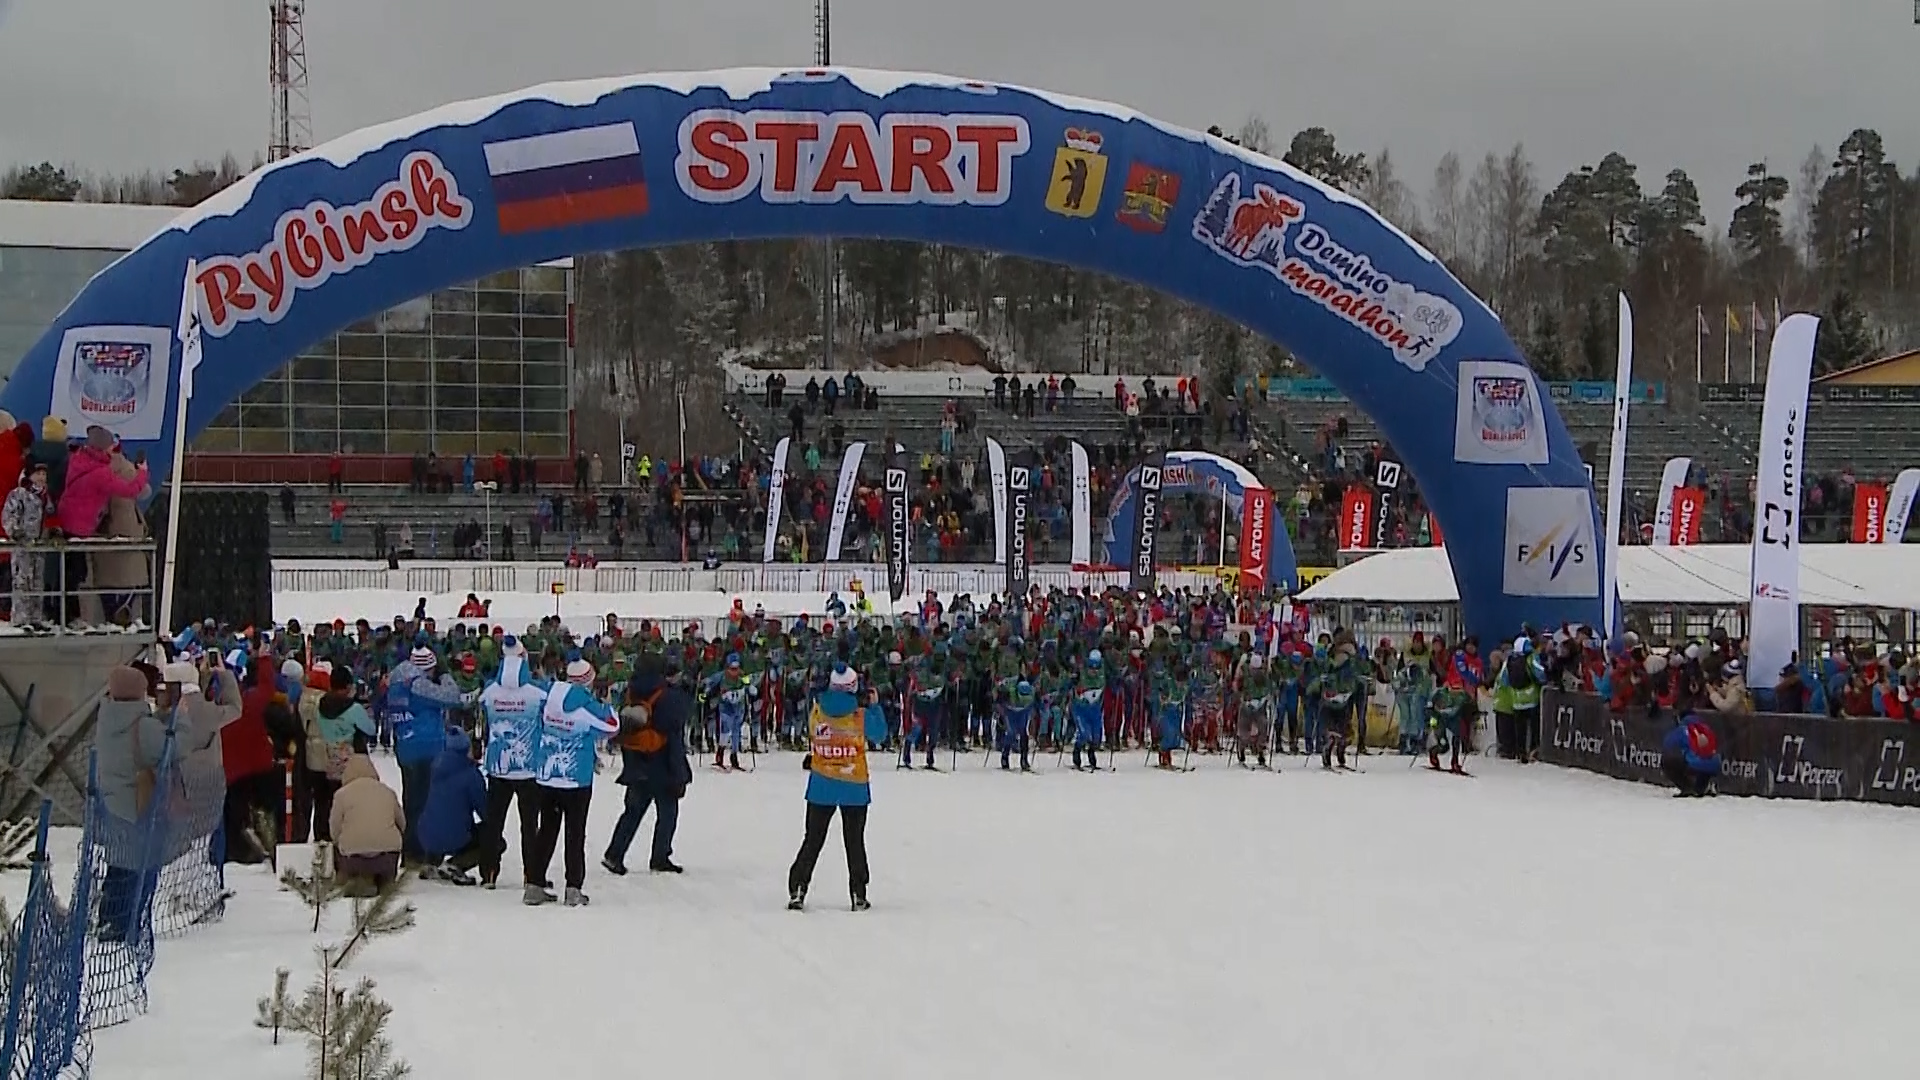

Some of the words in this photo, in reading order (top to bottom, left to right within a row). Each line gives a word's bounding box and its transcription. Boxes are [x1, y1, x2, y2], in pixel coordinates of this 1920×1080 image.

[688, 120, 1018, 192] START
[196, 157, 463, 326] Rybinsk
[1300, 229, 1388, 294] Demino
[1281, 262, 1409, 348] marathon
[1250, 496, 1266, 561] ATOMIC
[811, 743, 857, 758] MEDIA
[1800, 760, 1844, 786] Ростех
